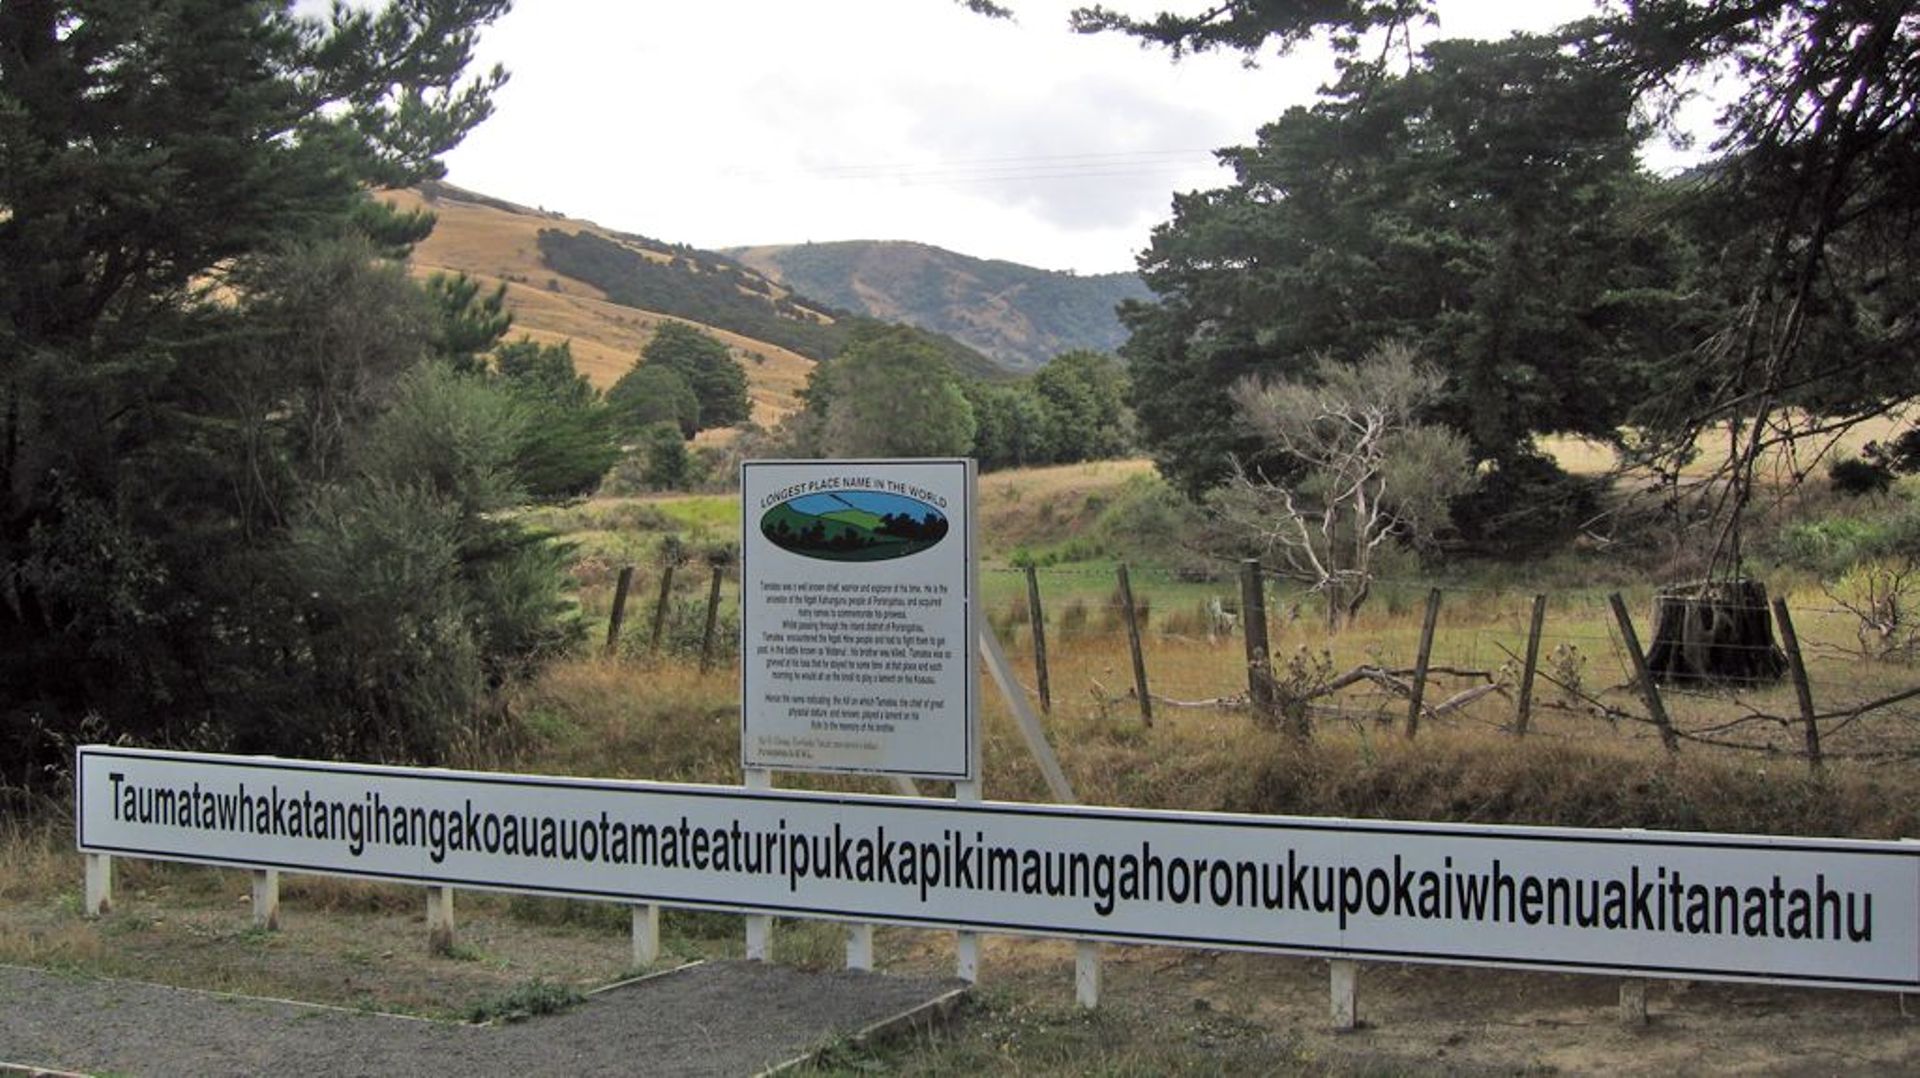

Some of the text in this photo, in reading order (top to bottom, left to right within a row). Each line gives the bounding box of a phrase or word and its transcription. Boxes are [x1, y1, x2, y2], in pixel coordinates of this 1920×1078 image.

[761, 476, 947, 508] LONGEST PLACE NAME IN THE WORLD
[109, 772, 1873, 942] Taumatawhakatangihangakoauauotamateaturipukakapikimaungahoronukupokaiwhenuakitanatahu
